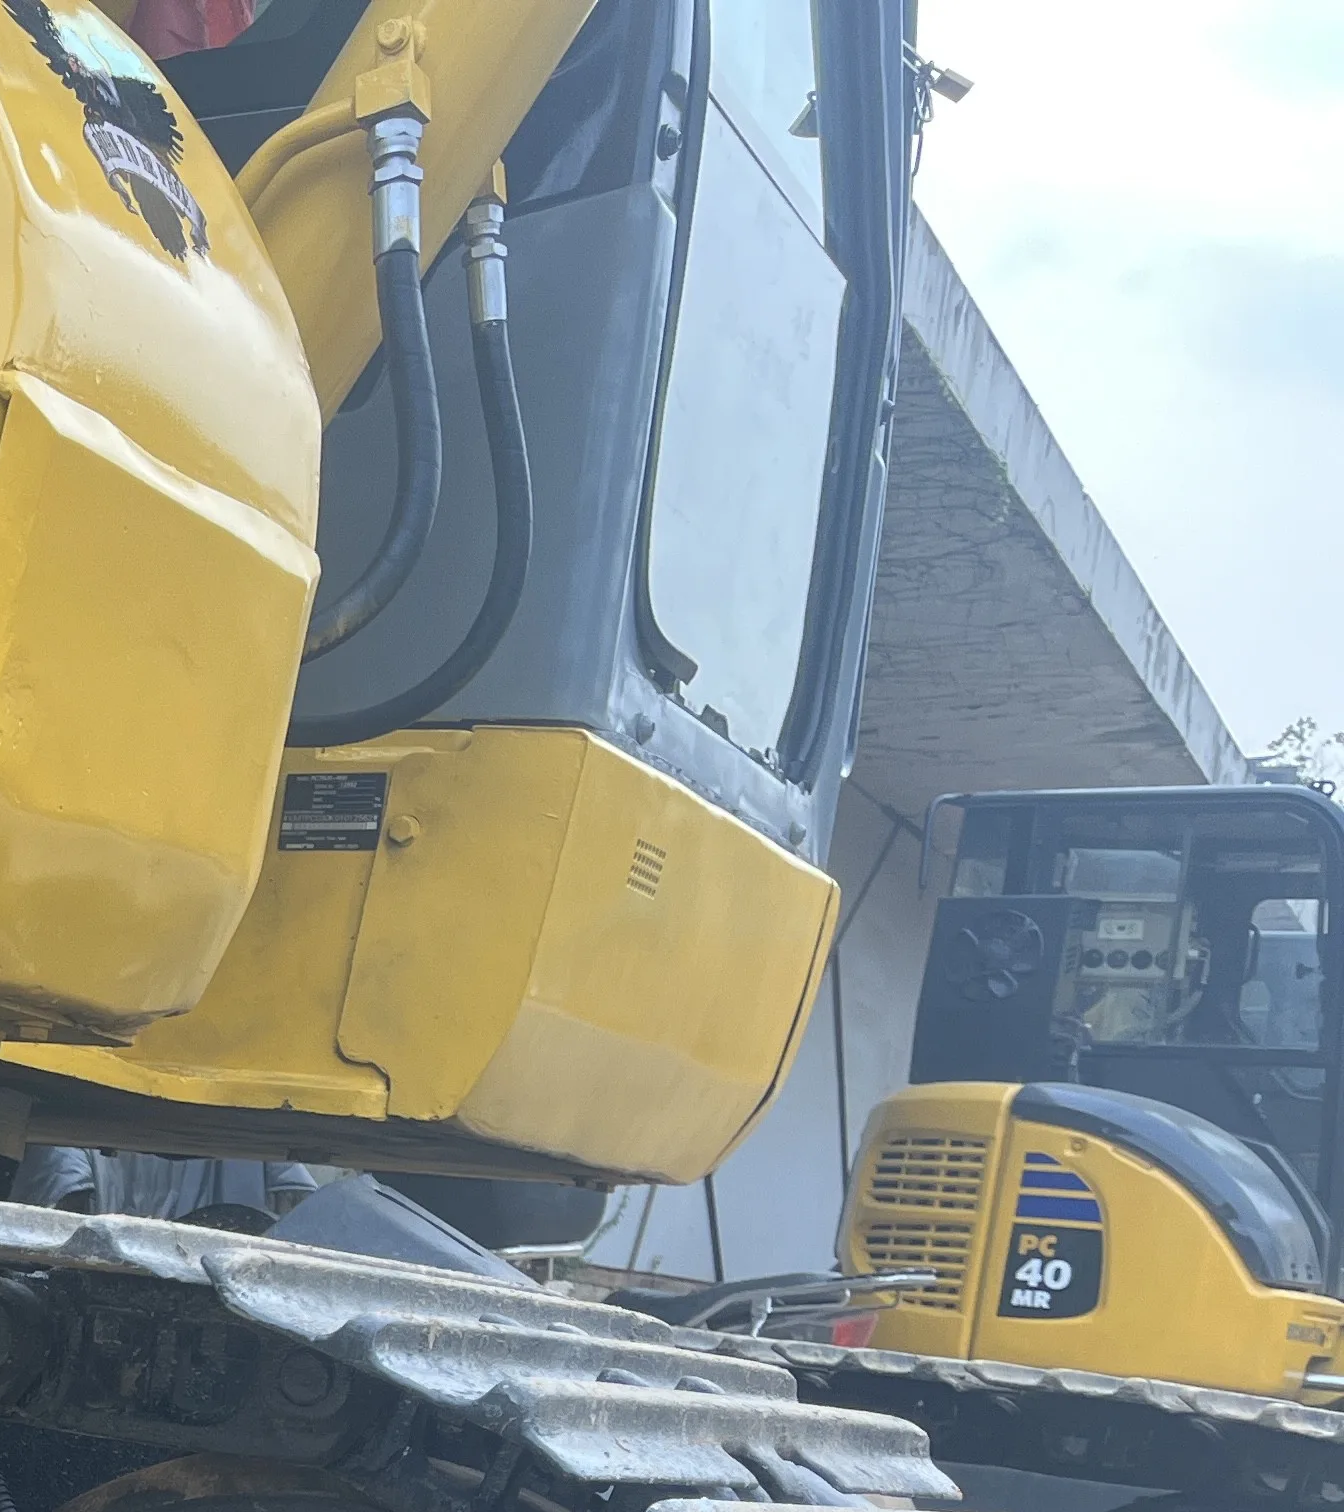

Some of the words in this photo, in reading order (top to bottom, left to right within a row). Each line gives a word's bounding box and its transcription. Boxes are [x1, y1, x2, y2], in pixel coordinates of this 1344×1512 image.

[1018, 1233, 1058, 1257] PC
[1015, 1258, 1072, 1290] 40
[1010, 1288, 1051, 1309] MR
